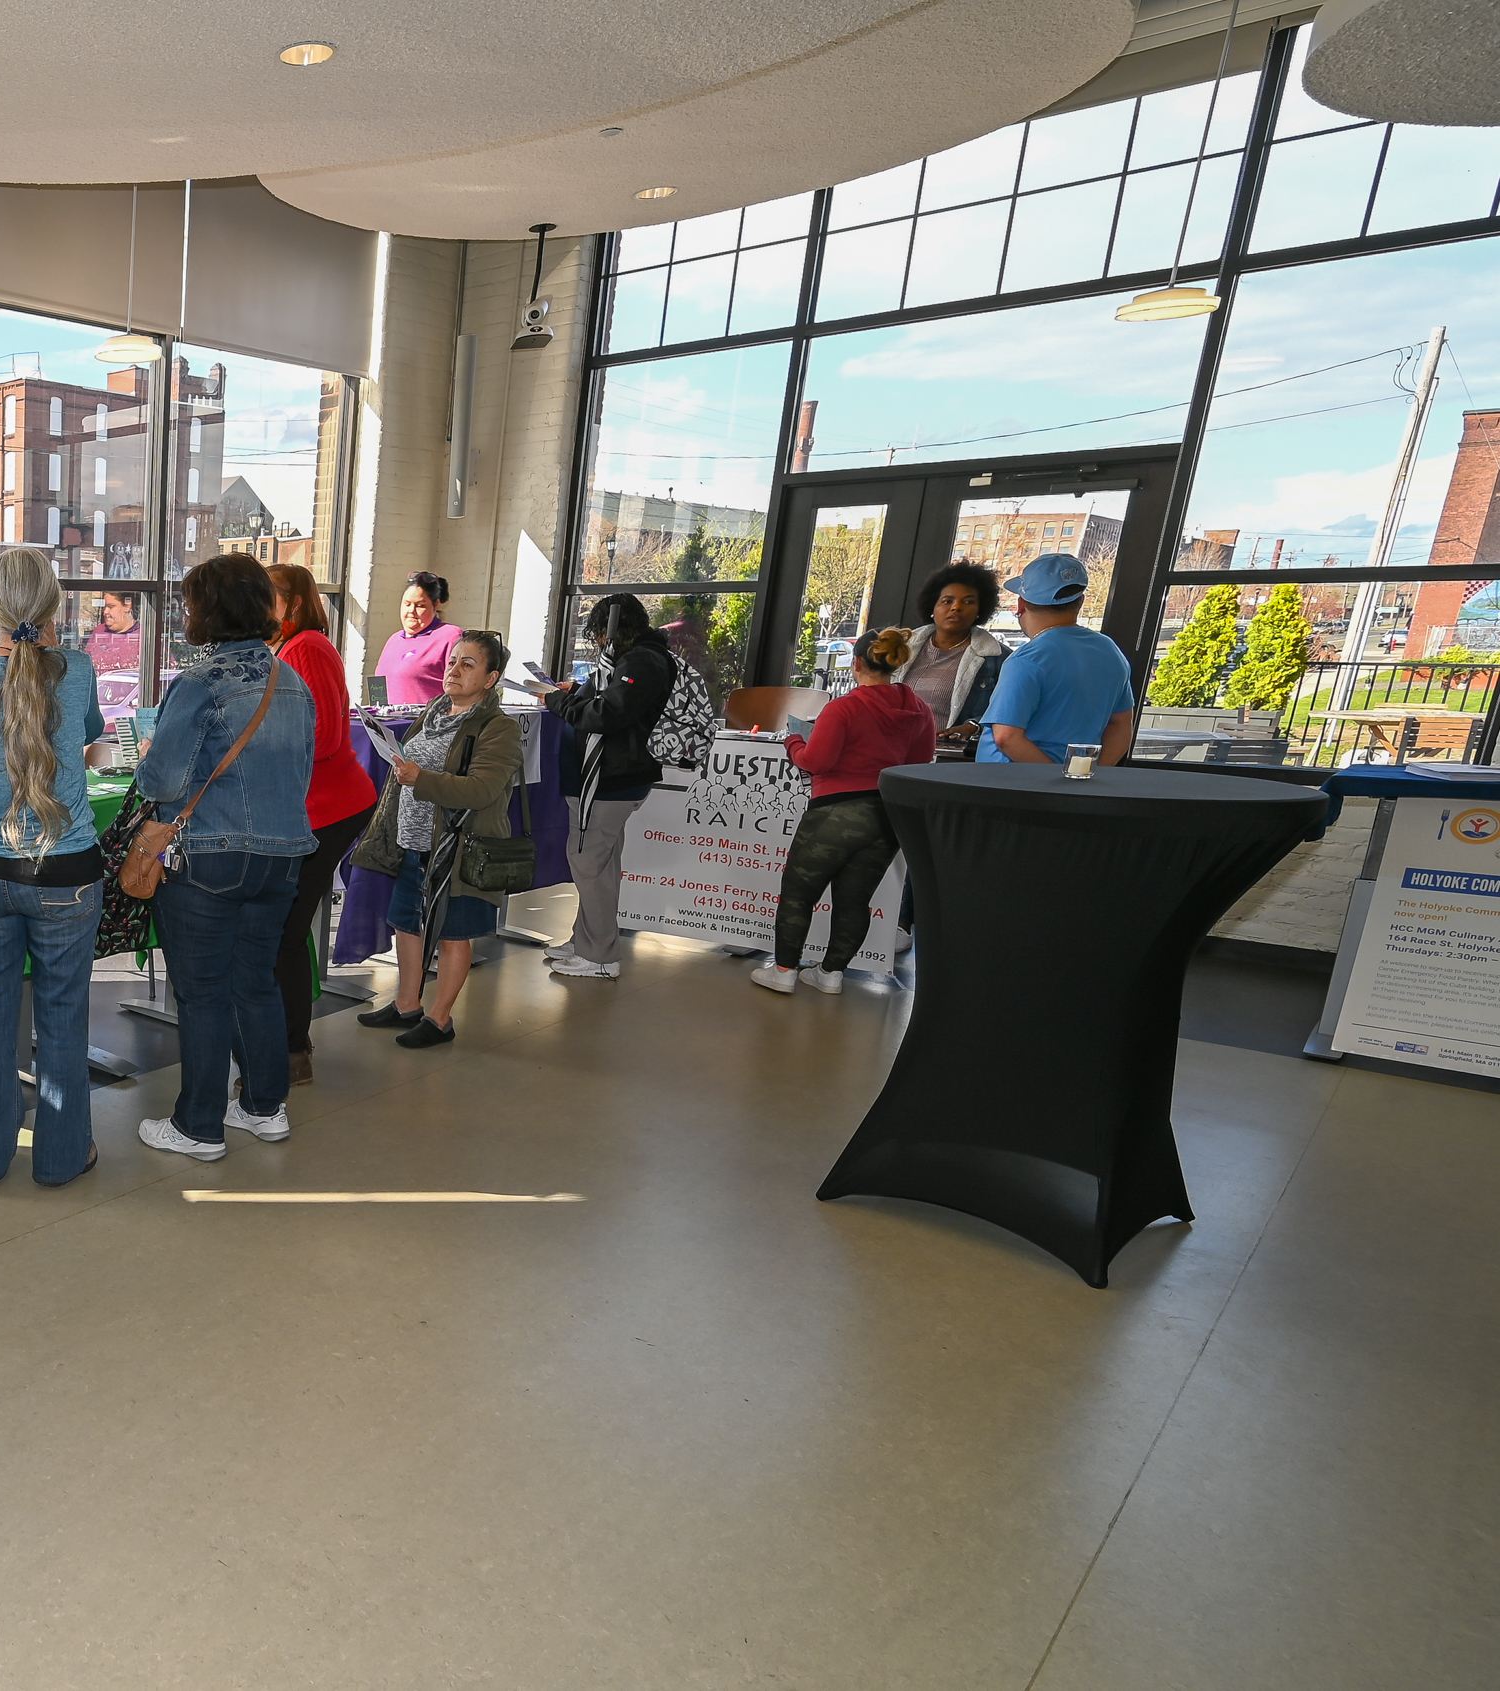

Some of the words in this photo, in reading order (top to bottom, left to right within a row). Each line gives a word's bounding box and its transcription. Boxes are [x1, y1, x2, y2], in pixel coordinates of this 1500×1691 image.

[704, 752, 800, 782] UESTR
[686, 808, 795, 836] RAICE
[643, 829, 685, 845] Office:
[689, 835, 714, 847] 329
[718, 837, 749, 852] Main
[753, 843, 770, 856] St.
[698, 851, 732, 867] (413)
[621, 870, 656, 885] Farm:
[659, 876, 675, 887] 24
[679, 879, 719, 893] Jones
[723, 884, 758, 901] Ferry
[1410, 872, 1469, 890] HOLYOKE
[693, 895, 727, 911] (413)
[731, 901, 777, 918] 640-95
[1394, 910, 1415, 918] now
[1418, 912, 1448, 922] open!
[1397, 899, 1417, 908] The
[1419, 902, 1463, 913] Holyoke
[643, 914, 656, 922] on
[658, 915, 707, 930] Facebook
[721, 925, 774, 942] Instagram:
[1390, 923, 1414, 933] HCC
[1416, 926, 1446, 936] MGM
[1449, 930, 1496, 944] Culinary
[1388, 934, 1407, 942] 164
[1410, 936, 1437, 946] Race
[1439, 940, 1454, 948] St.
[1385, 944, 1443, 958] Thursdays:
[1445, 951, 1488, 963] 2:30pm
